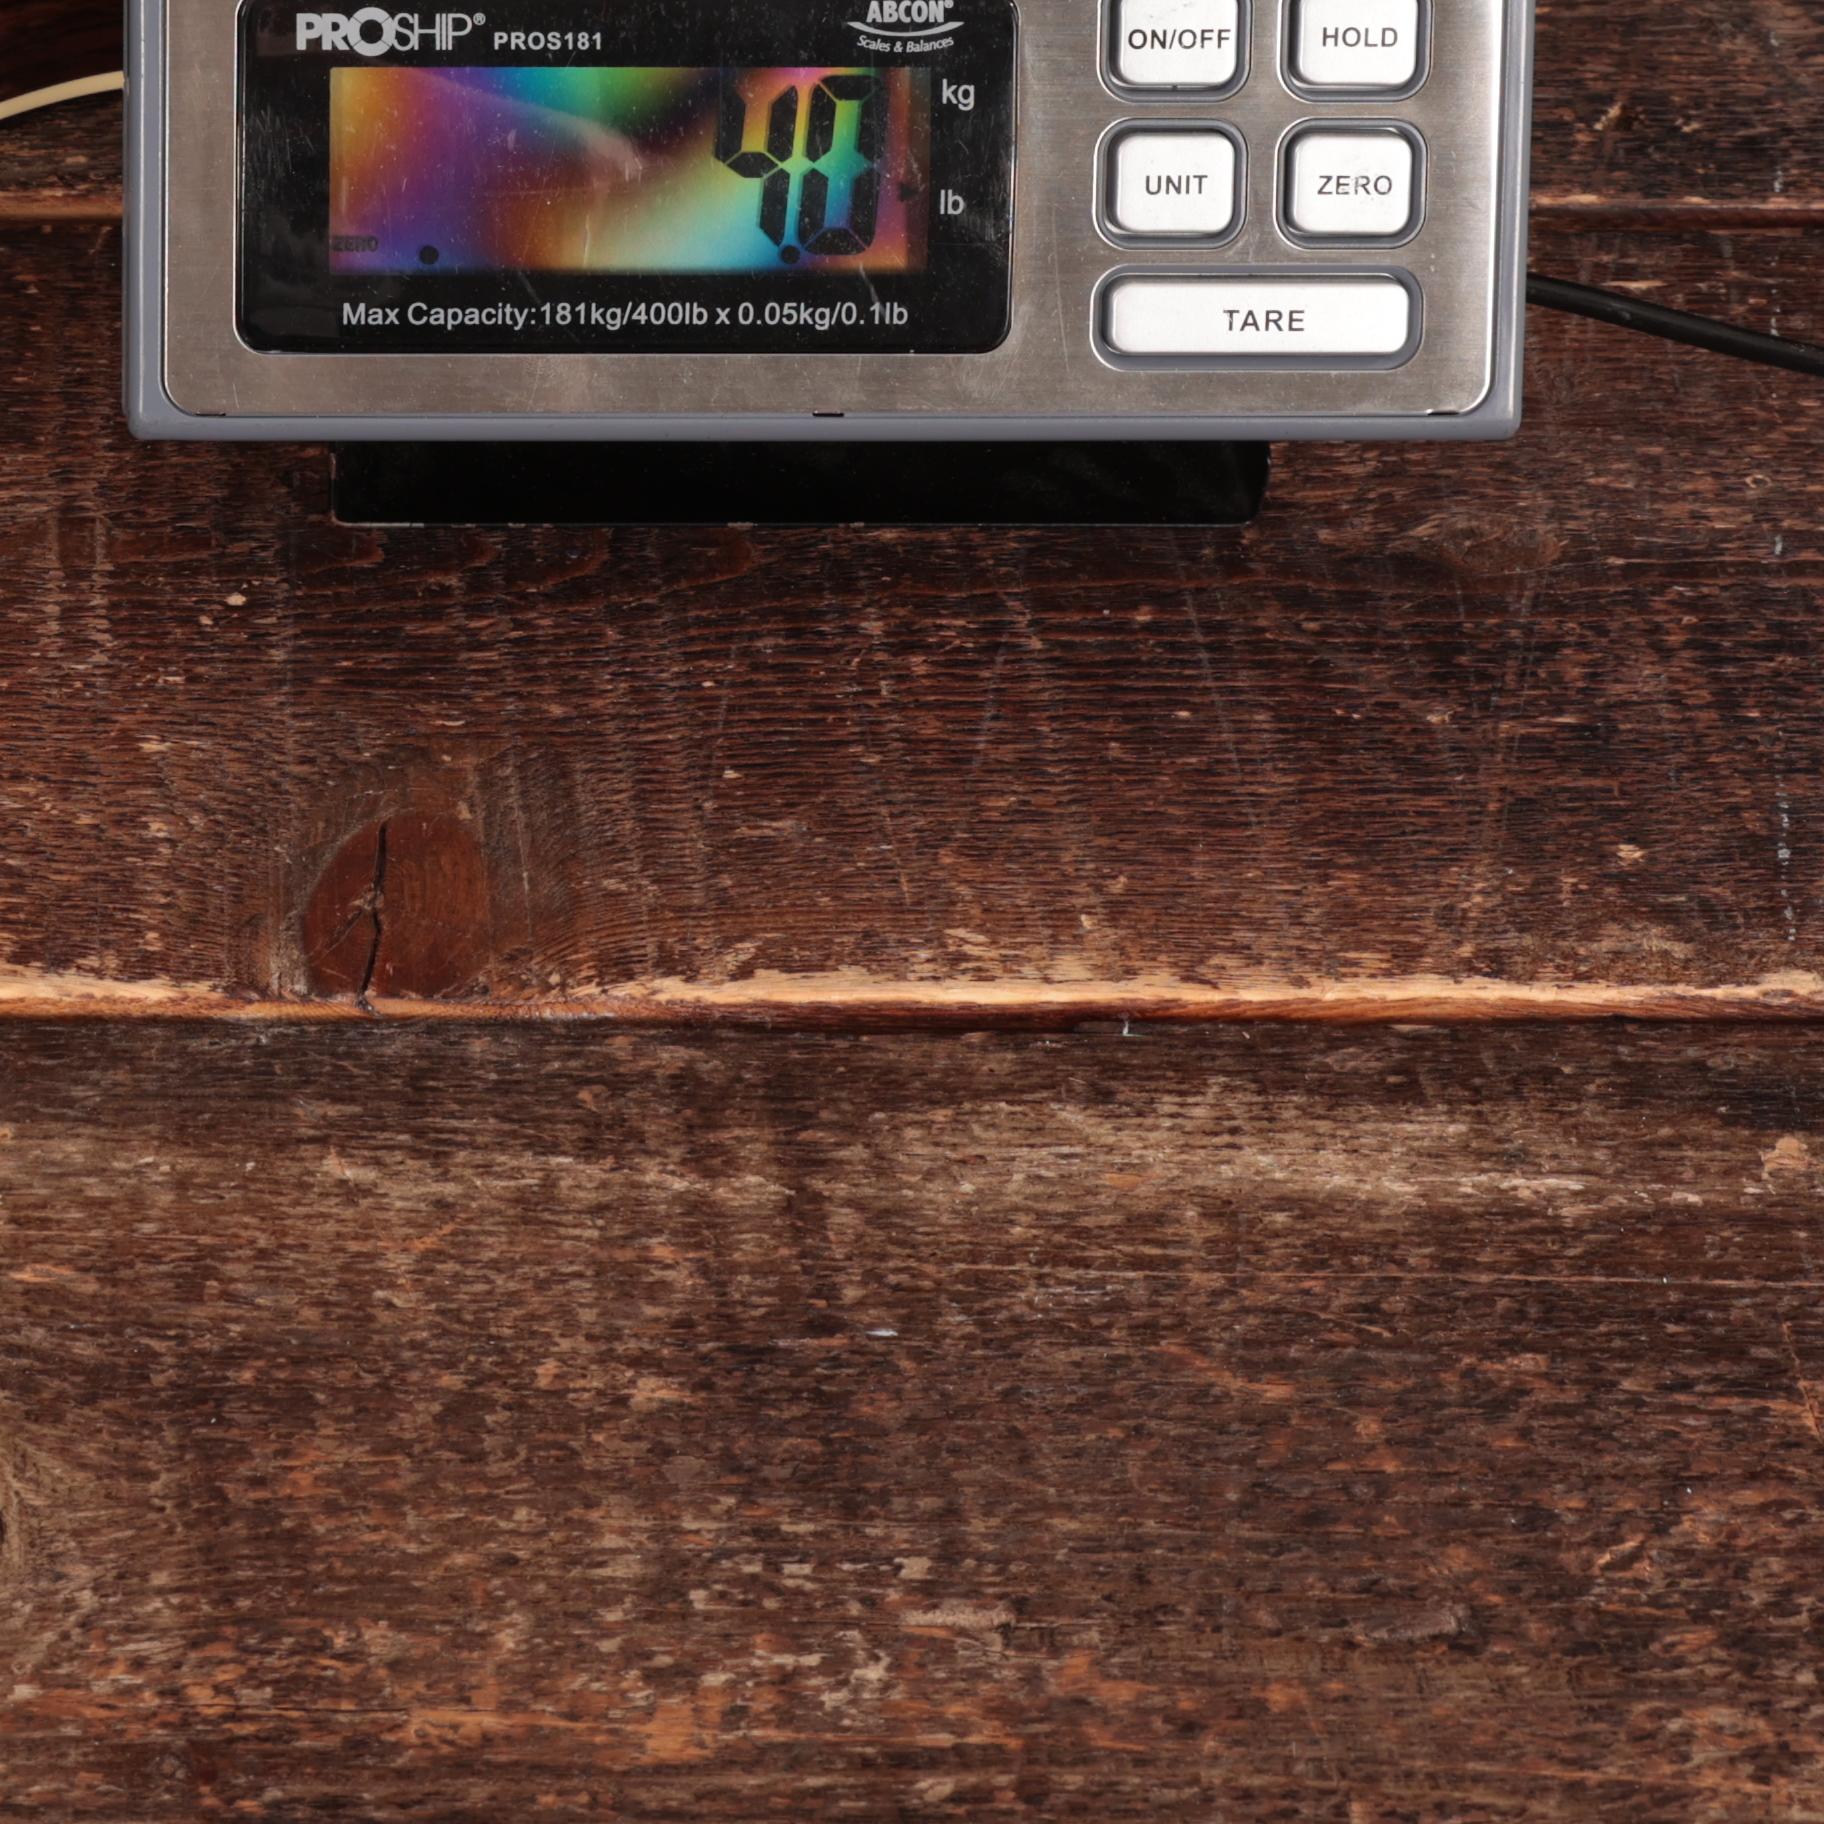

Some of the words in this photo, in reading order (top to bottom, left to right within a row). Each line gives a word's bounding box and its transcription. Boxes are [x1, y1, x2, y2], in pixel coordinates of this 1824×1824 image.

[493, 32, 603, 51] PROS181
[857, 34, 891, 52] Scales
[893, 41, 903, 53] &
[906, 37, 954, 53] Balances
[1128, 28, 1231, 50] ON/OFF
[1322, 27, 1398, 48] HOLD
[941, 79, 975, 110] kg
[1145, 175, 1208, 195] UNIT
[1317, 175, 1392, 195] ZERO
[939, 189, 965, 215] lb
[342, 302, 400, 325] Max
[715, 307, 731, 325] x
[737, 301, 908, 330] 0.05kg/0.1lb
[1224, 309, 1305, 332] TARE
